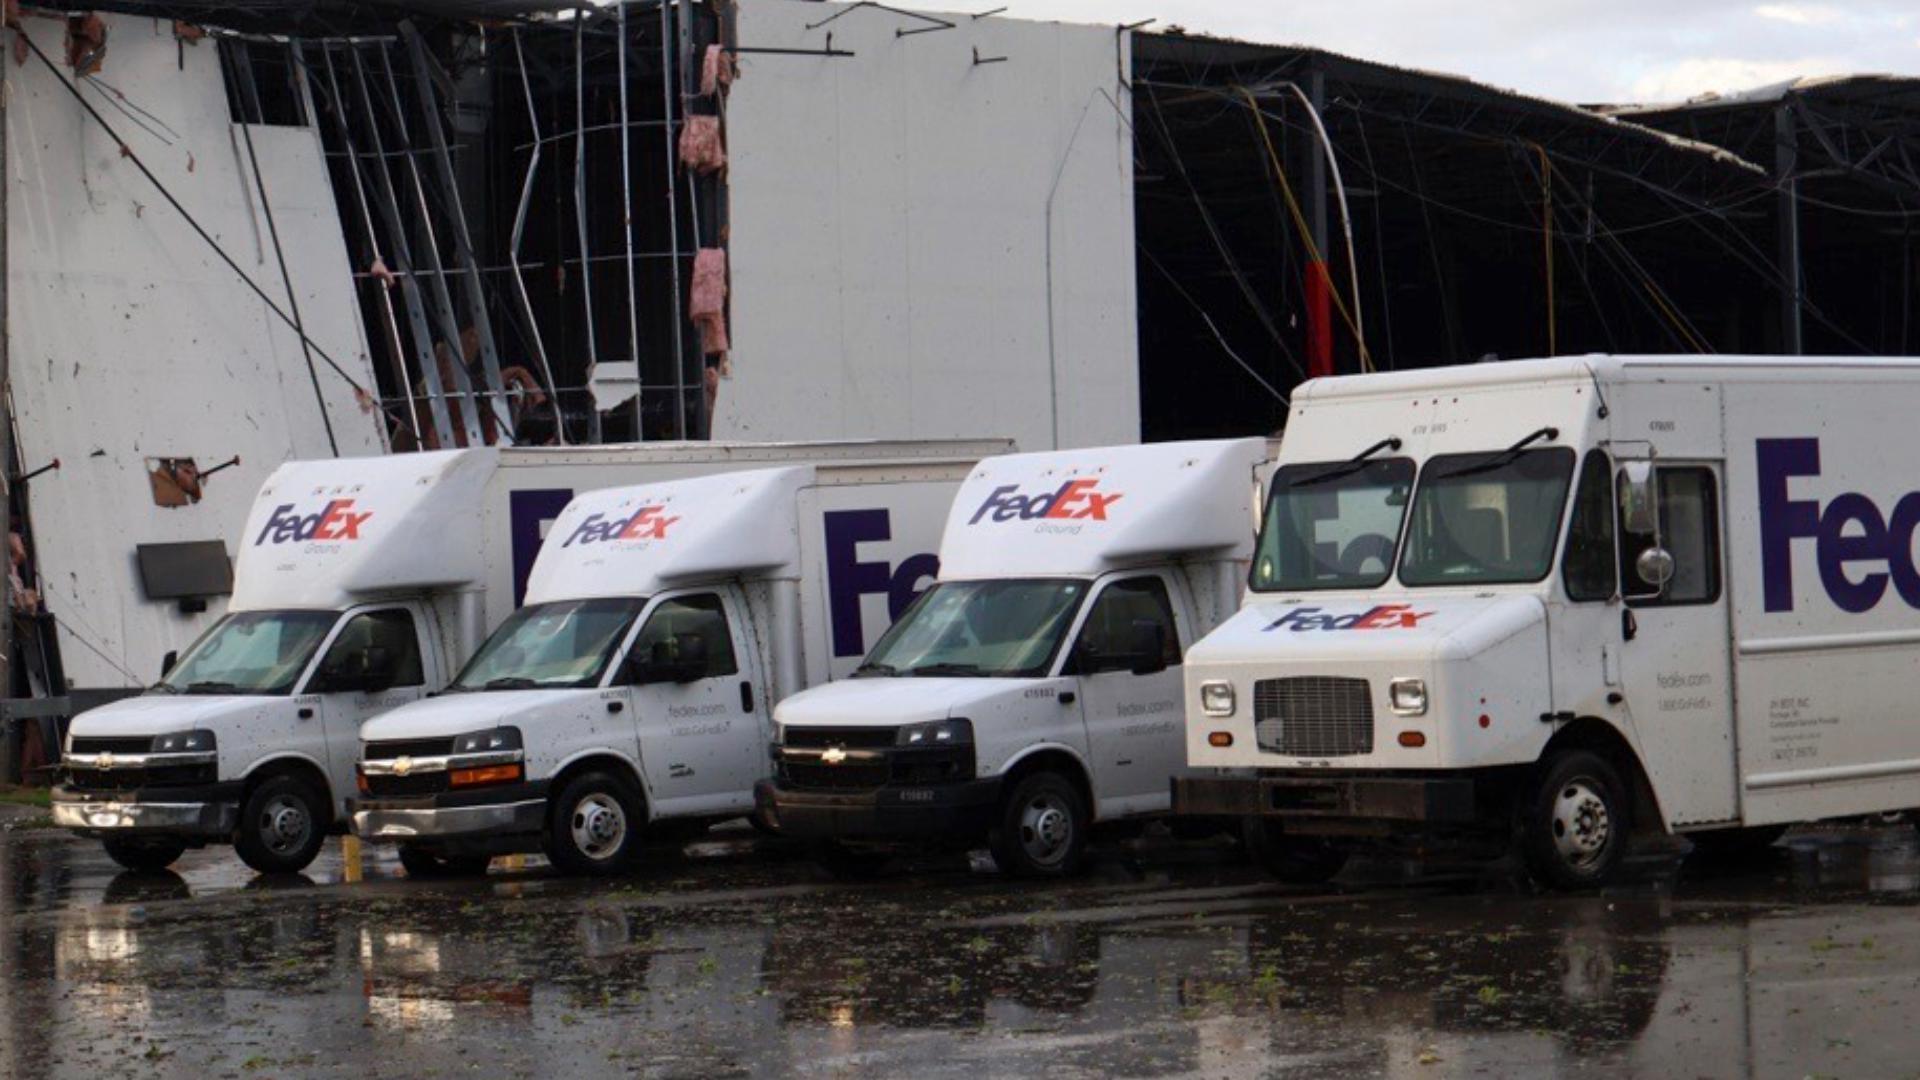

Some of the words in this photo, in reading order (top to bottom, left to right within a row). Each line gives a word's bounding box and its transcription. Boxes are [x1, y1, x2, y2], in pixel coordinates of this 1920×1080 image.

[255, 498, 373, 546] FedEx
[968, 479, 1124, 526] FedEx
[562, 505, 683, 548] FedEx
[1033, 521, 1084, 536] Ground
[1260, 603, 1436, 633] FedEx
